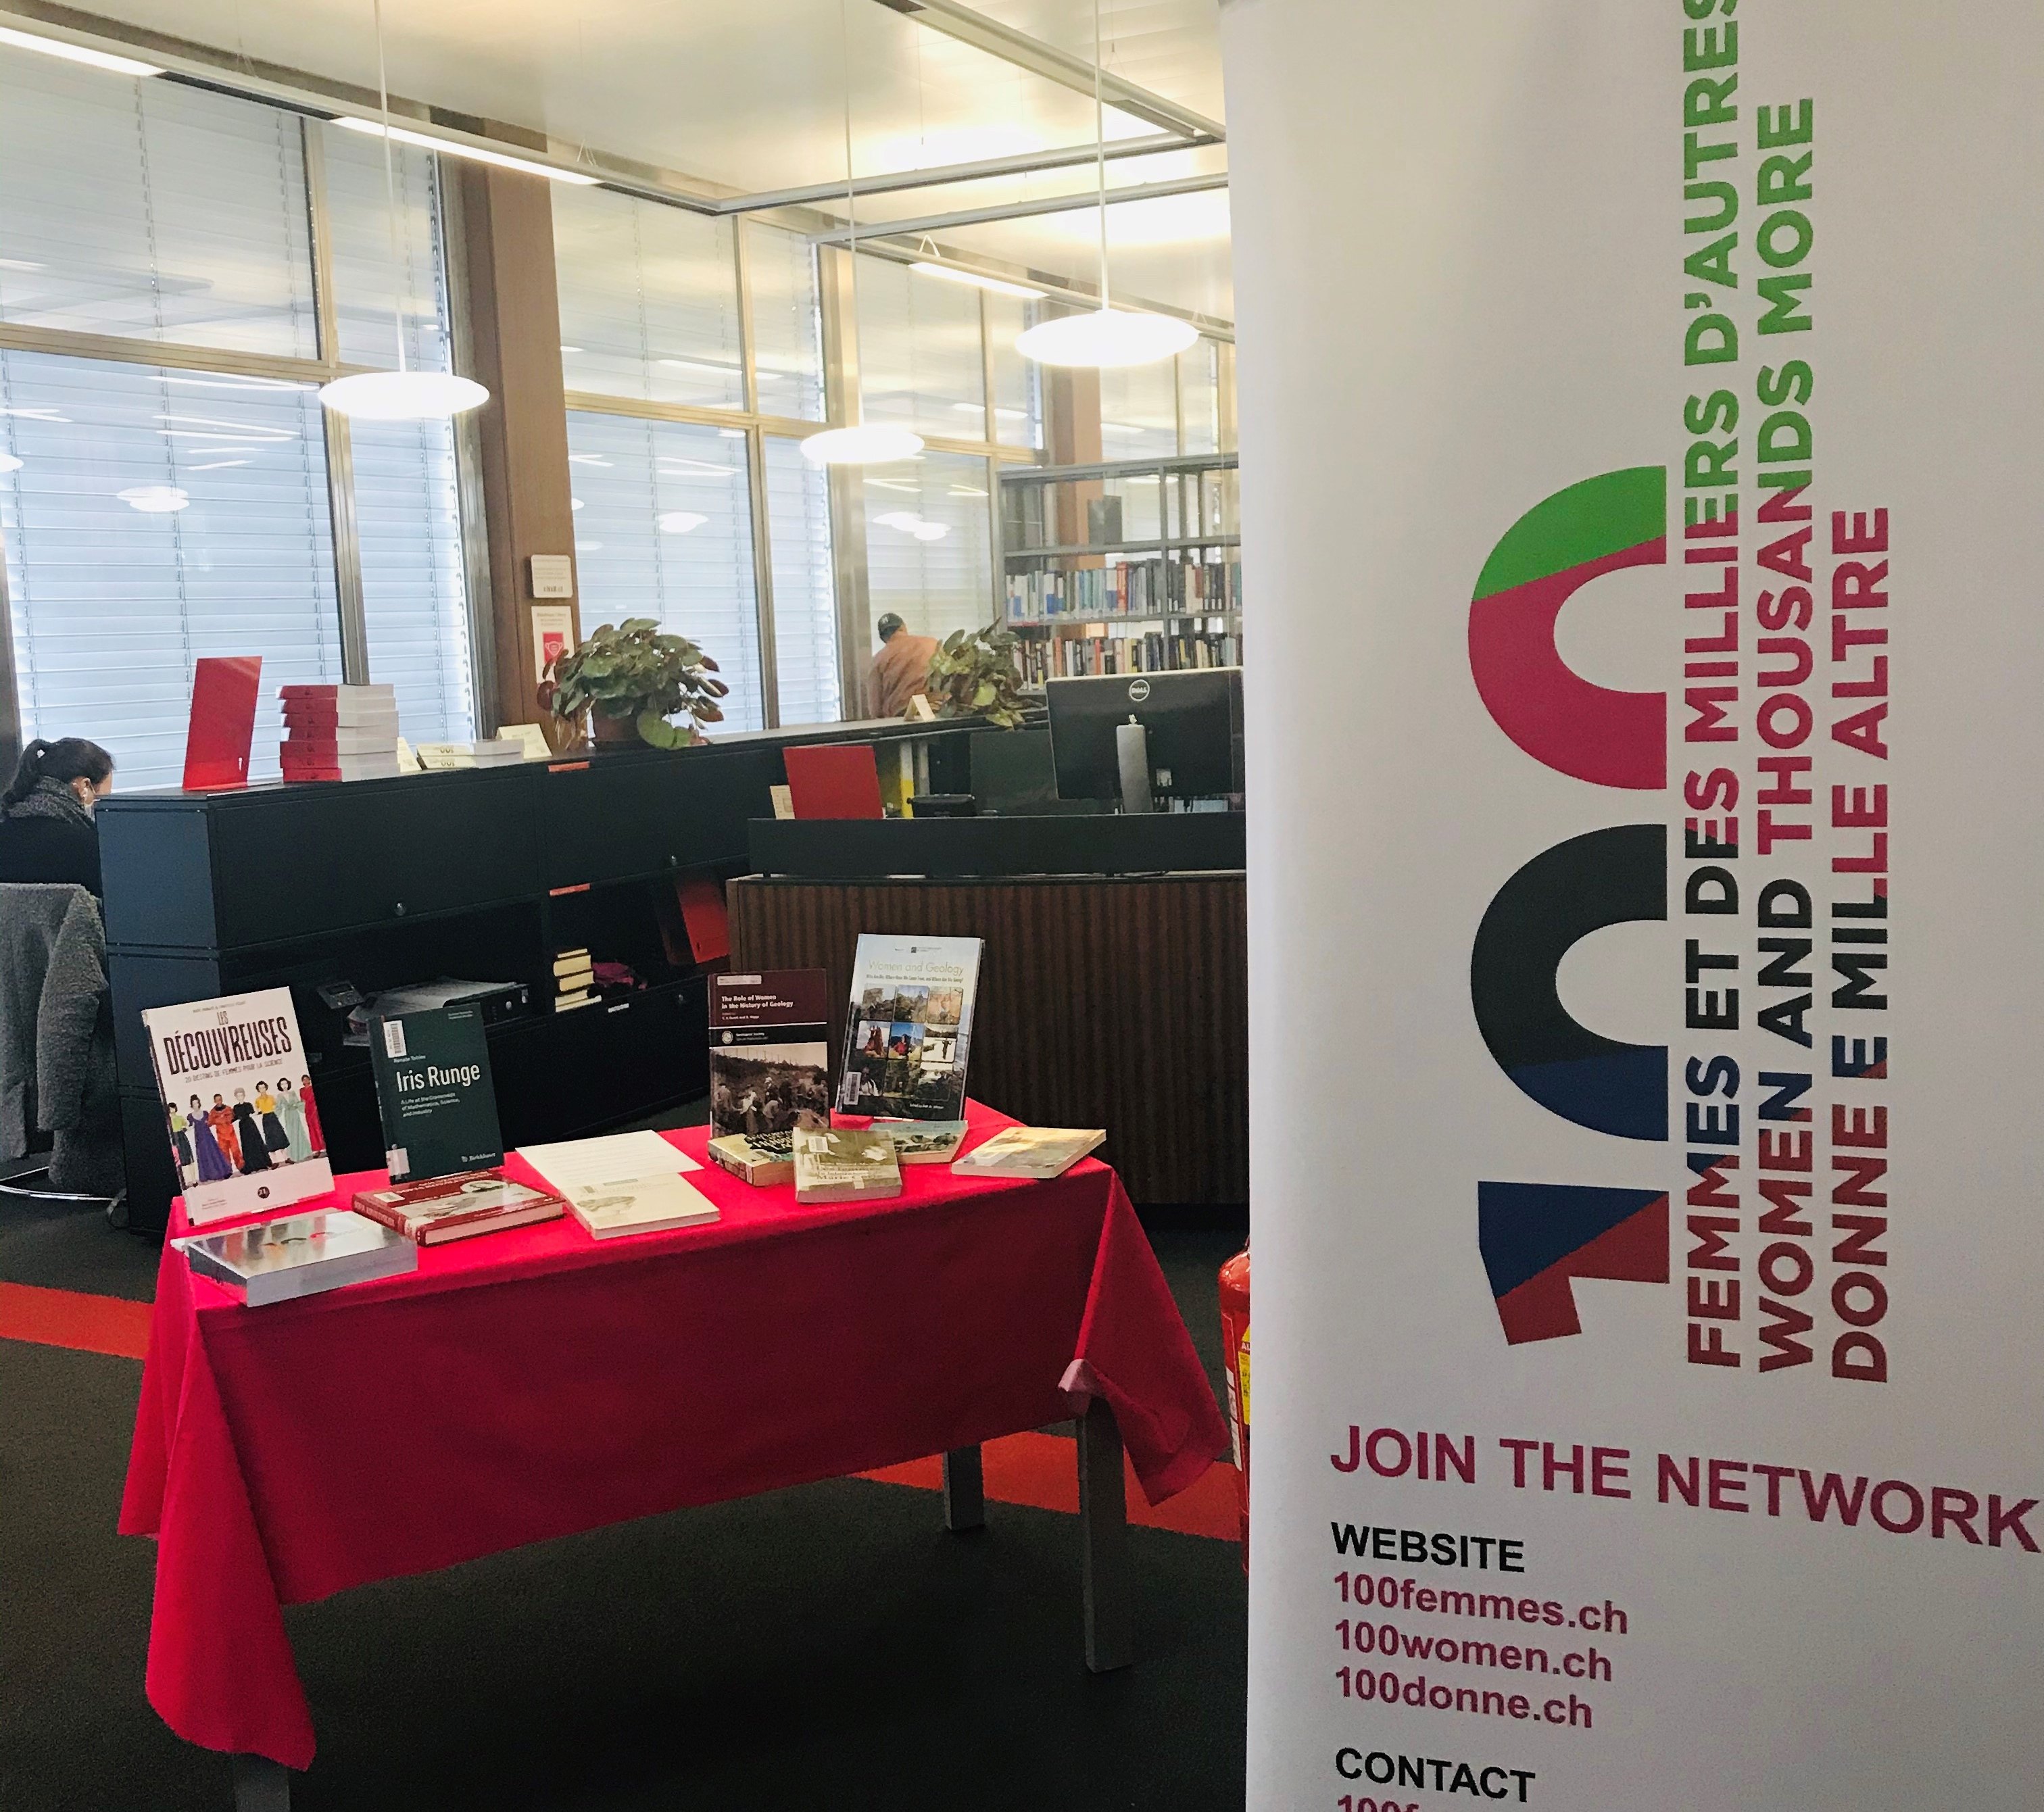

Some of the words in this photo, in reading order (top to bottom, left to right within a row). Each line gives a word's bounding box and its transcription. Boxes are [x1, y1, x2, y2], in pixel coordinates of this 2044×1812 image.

[1757, 99, 1813, 335] MORE
[1684, 390, 1738, 742] MILLIERS
[1757, 360, 1813, 855] THOUSANDS
[1831, 508, 1888, 760] ALTRE
[1684, 768, 1739, 914] DES
[1832, 784, 1888, 1010] MILLE
[216, 1011, 229, 1025] LES
[869, 960, 902, 971] Women
[905, 960, 923, 972] and
[926, 962, 964, 976] Geology
[1685, 939, 1739, 1030] ET
[1757, 879, 1812, 1049] AND
[164, 1017, 292, 1075] DÉCOUVREUSES
[397, 1070, 425, 1092] Iris
[427, 1064, 481, 1087] Runge
[1832, 1035, 1887, 1079] E
[1685, 1056, 1741, 1367] FEMMES
[1758, 1072, 1814, 1373] WOMEN
[1831, 1104, 1888, 1383] DONNE
[1331, 1425, 1475, 1484] JOIN
[1499, 1438, 1631, 1499] THE
[1658, 1454, 2041, 1553] NETWORK
[1331, 1522, 1525, 1573] WEBSITE
[1334, 1571, 1628, 1634] 100femmes.ch
[1335, 1619, 1612, 1682] 100women.ch
[1336, 1666, 1592, 1728] 100donne.ch
[1336, 1748, 1536, 1803] CONTACT
